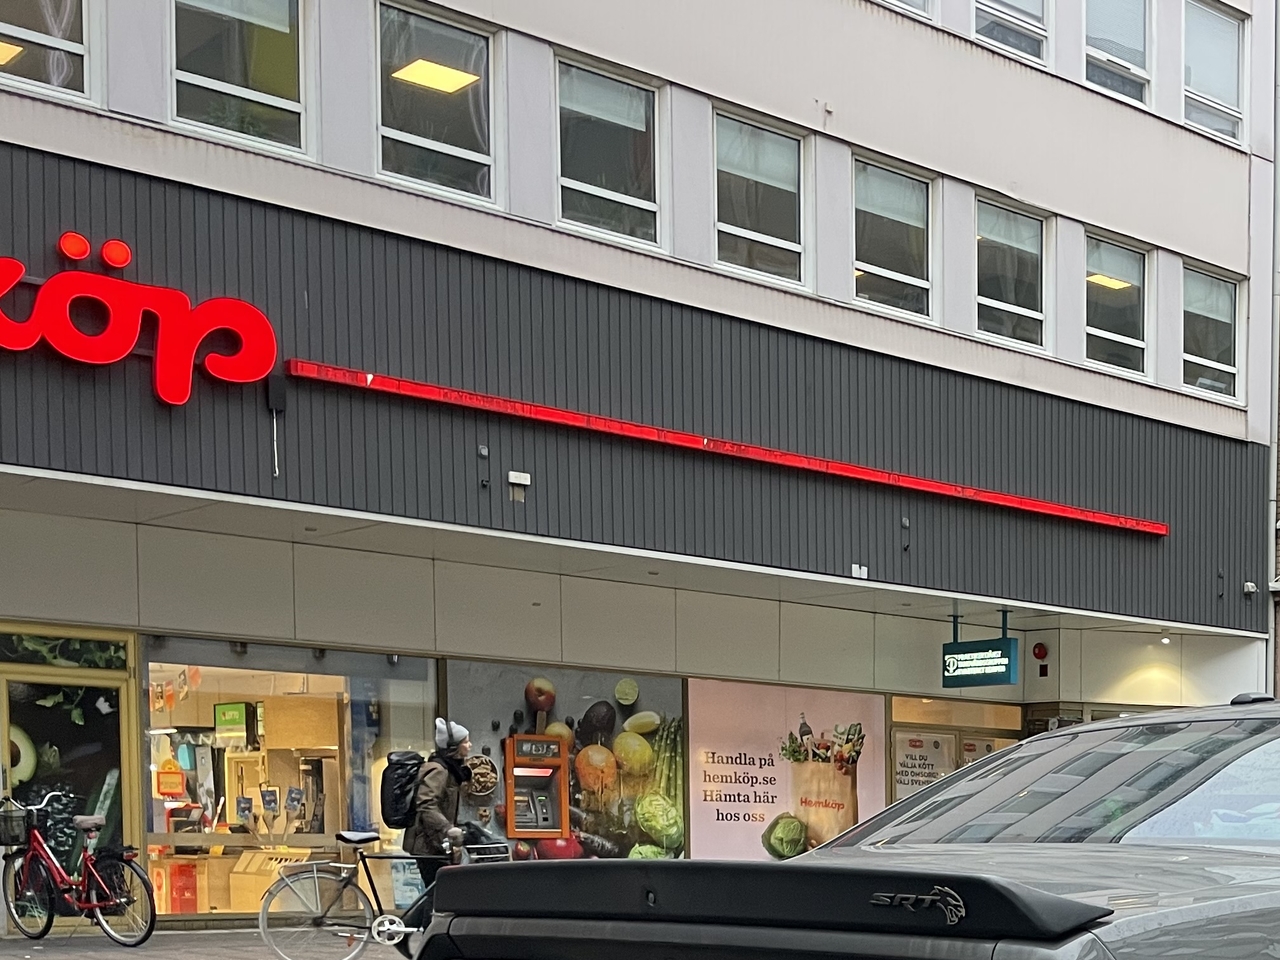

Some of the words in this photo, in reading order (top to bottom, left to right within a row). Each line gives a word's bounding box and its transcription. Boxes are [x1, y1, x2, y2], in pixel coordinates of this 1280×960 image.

[704, 751, 756, 766] Handla
[758, 753, 775, 769] på
[899, 761, 917, 769] VÄLJA
[918, 762, 934, 770] KÖTT
[703, 770, 777, 787] hemköp.se
[702, 789, 750, 803] Hämta
[753, 791, 777, 804] här
[800, 797, 845, 812] Hemköp
[716, 809, 740, 822] hos
[743, 812, 765, 822] oss
[869, 892, 941, 913] SRT
